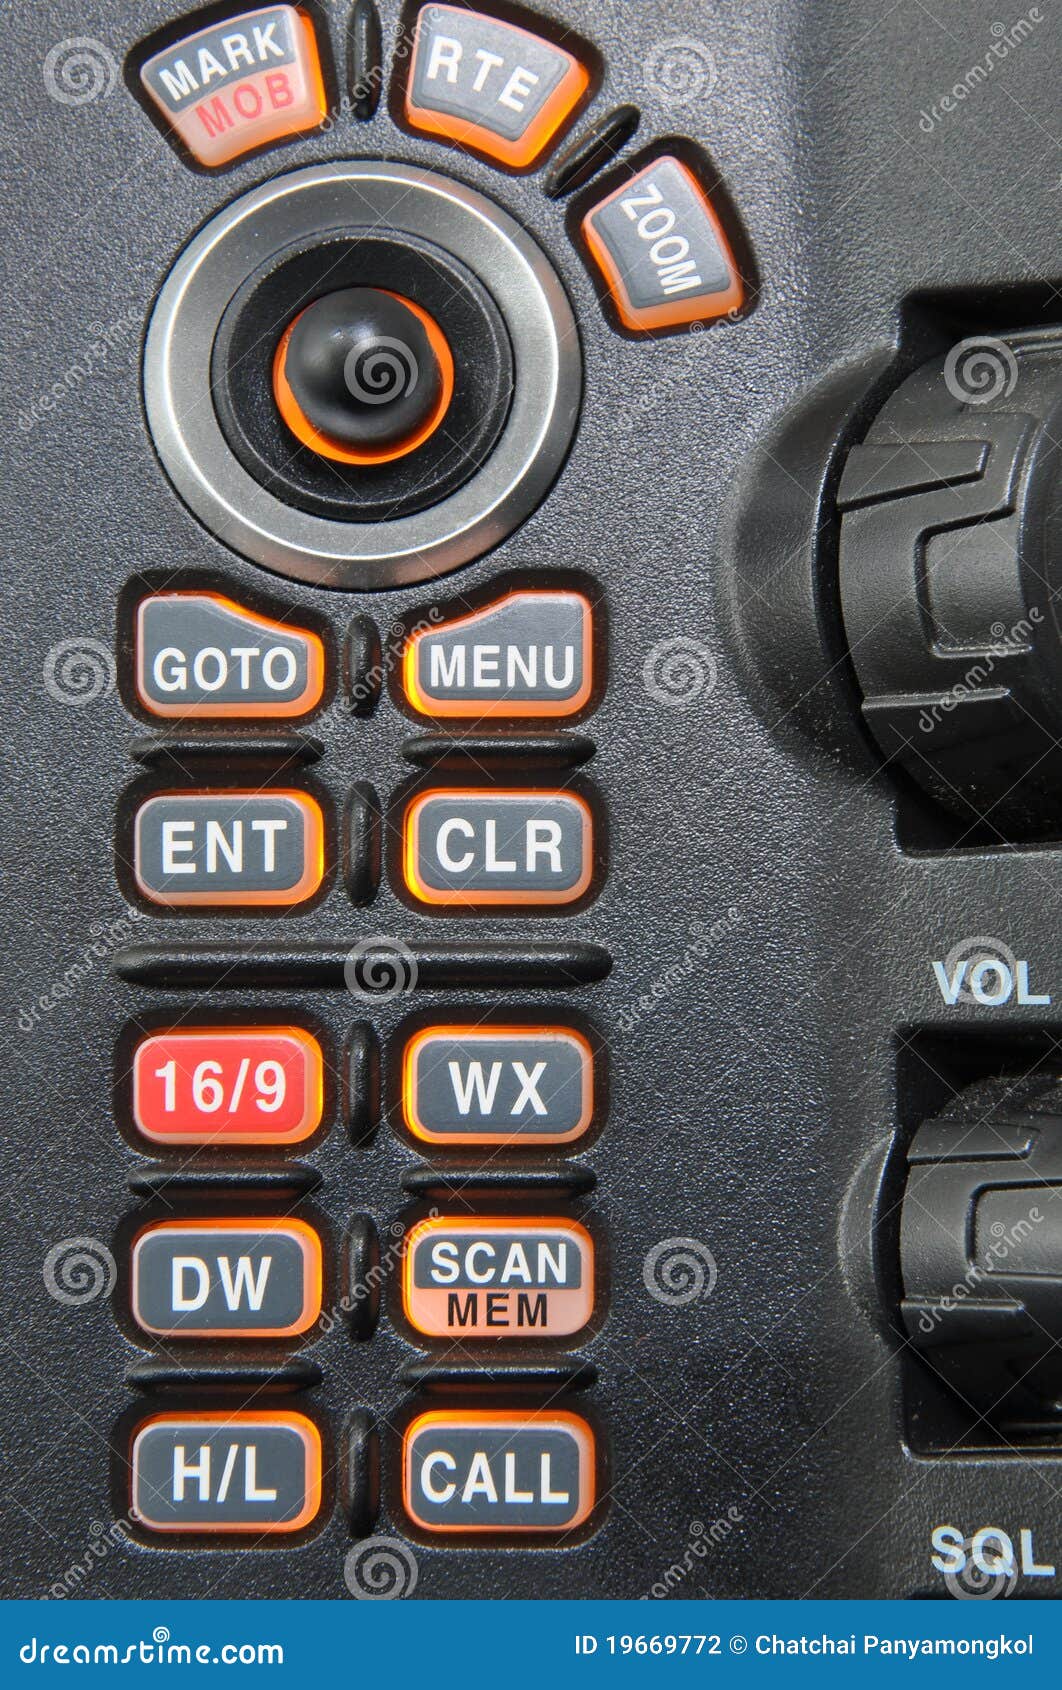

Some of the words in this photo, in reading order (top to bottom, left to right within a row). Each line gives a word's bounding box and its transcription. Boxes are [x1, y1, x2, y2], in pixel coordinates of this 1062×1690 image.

[158, 22, 285, 102] MARK
[426, 36, 539, 112] RTE
[196, 72, 296, 138] MOB
[619, 184, 702, 296] ZOOM
[153, 646, 298, 692] GOTO
[429, 644, 575, 689] MENU
[161, 819, 287, 874] ENT
[435, 817, 562, 873] CLR
[931, 960, 1051, 1006] VOL
[154, 1058, 287, 1113] 16/9
[448, 1061, 548, 1115] WX
[171, 1256, 272, 1312] DW
[430, 1241, 567, 1285] SCAN
[447, 1293, 549, 1328] MEM
[172, 1444, 277, 1502] H/L
[420, 1451, 570, 1504] CALL
[931, 1525, 1056, 1577] SQL
